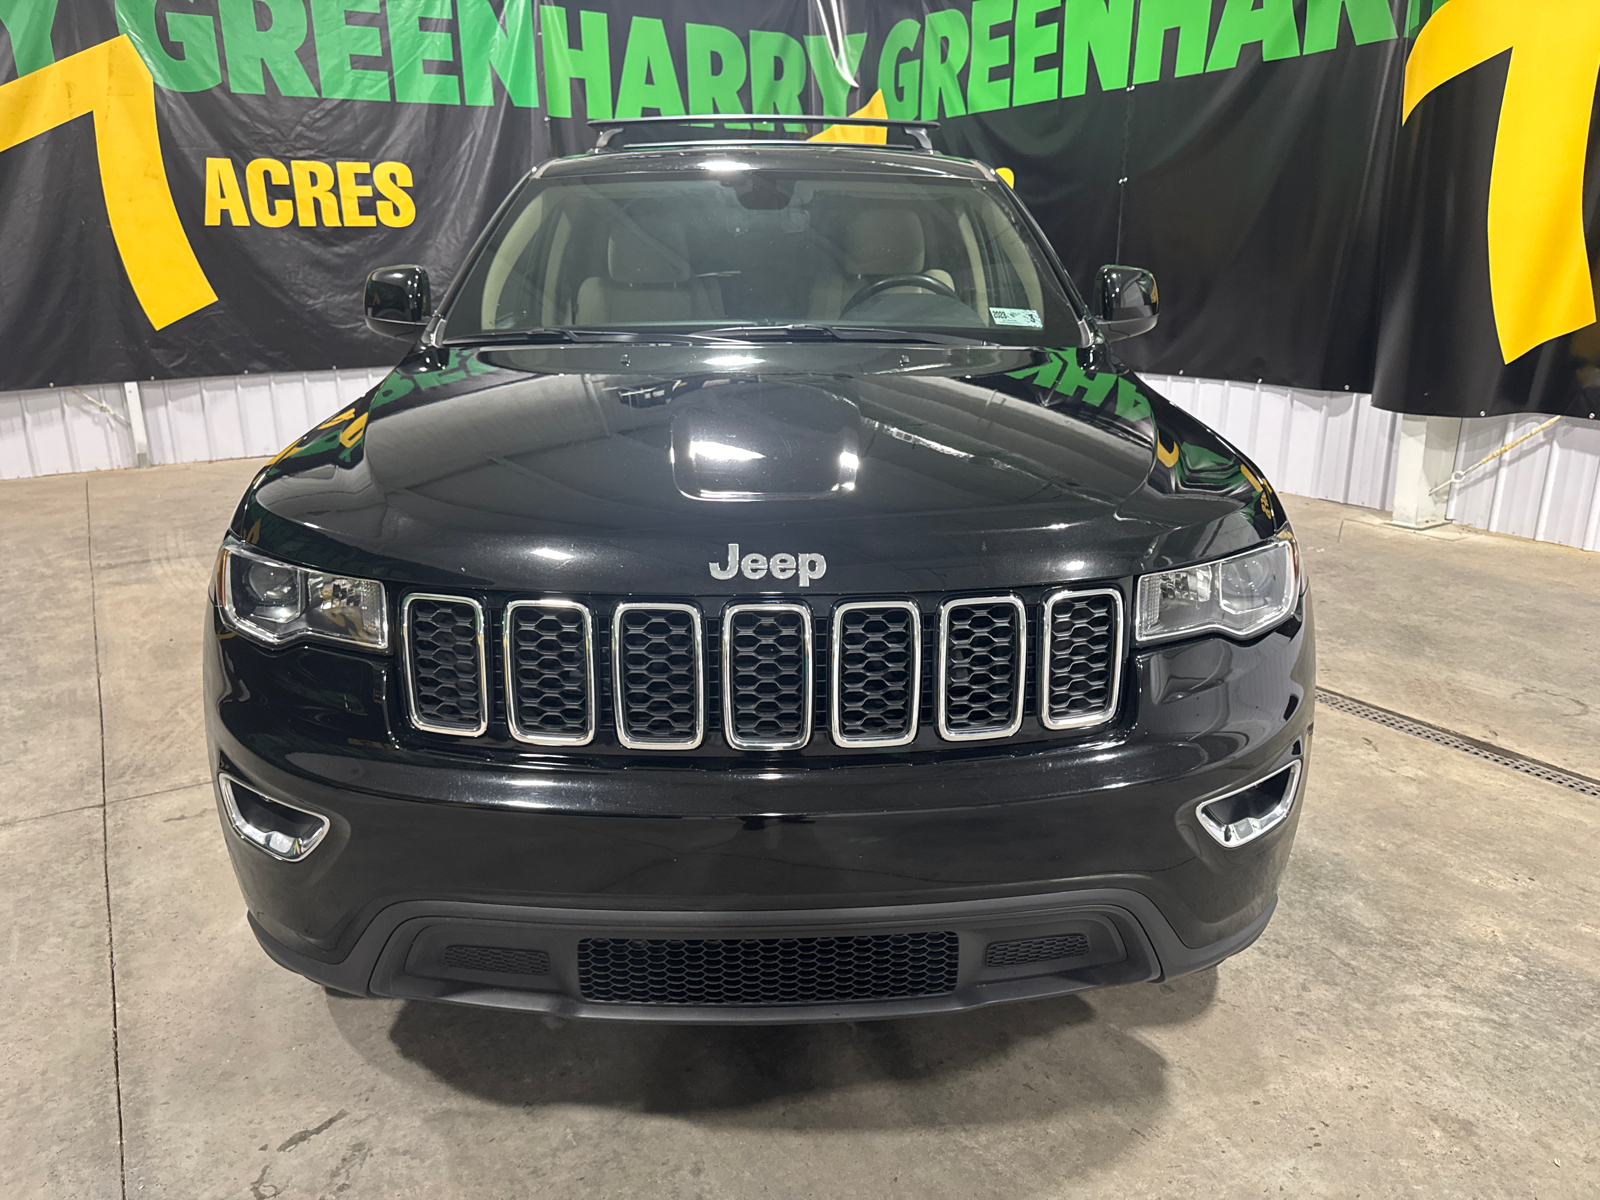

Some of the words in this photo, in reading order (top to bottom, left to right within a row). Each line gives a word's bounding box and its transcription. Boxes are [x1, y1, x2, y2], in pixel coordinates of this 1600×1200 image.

[114, 0, 539, 108] GREEN
[540, 4, 869, 134] HARRY
[877, 0, 1135, 122] GREEN
[204, 157, 416, 228] ACRES
[708, 543, 827, 588] Jeep
